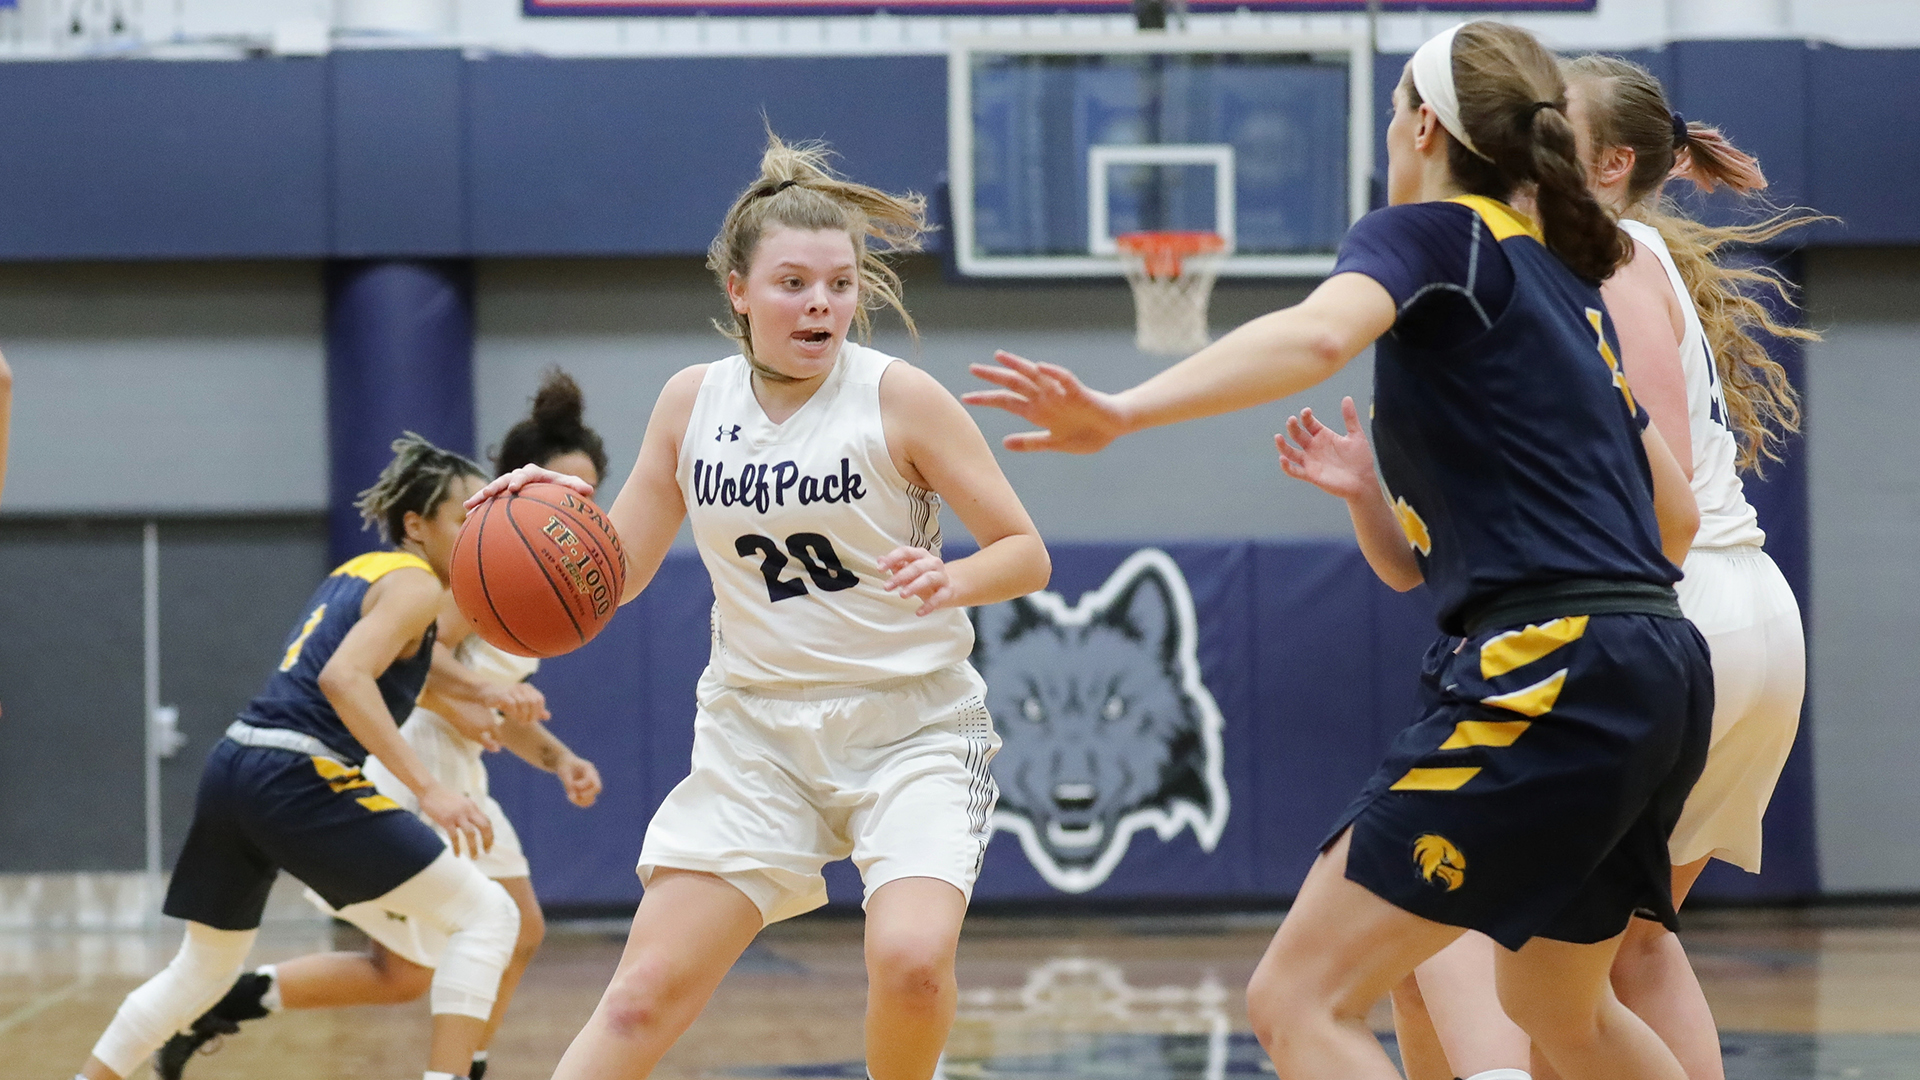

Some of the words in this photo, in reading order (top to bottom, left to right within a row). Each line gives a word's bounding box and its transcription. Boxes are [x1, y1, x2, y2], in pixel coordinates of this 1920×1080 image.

[694, 457, 867, 515] WolfPack
[543, 515, 610, 616] TF-1000
[560, 493, 627, 579] SPALDIN
[734, 532, 860, 603] 20
